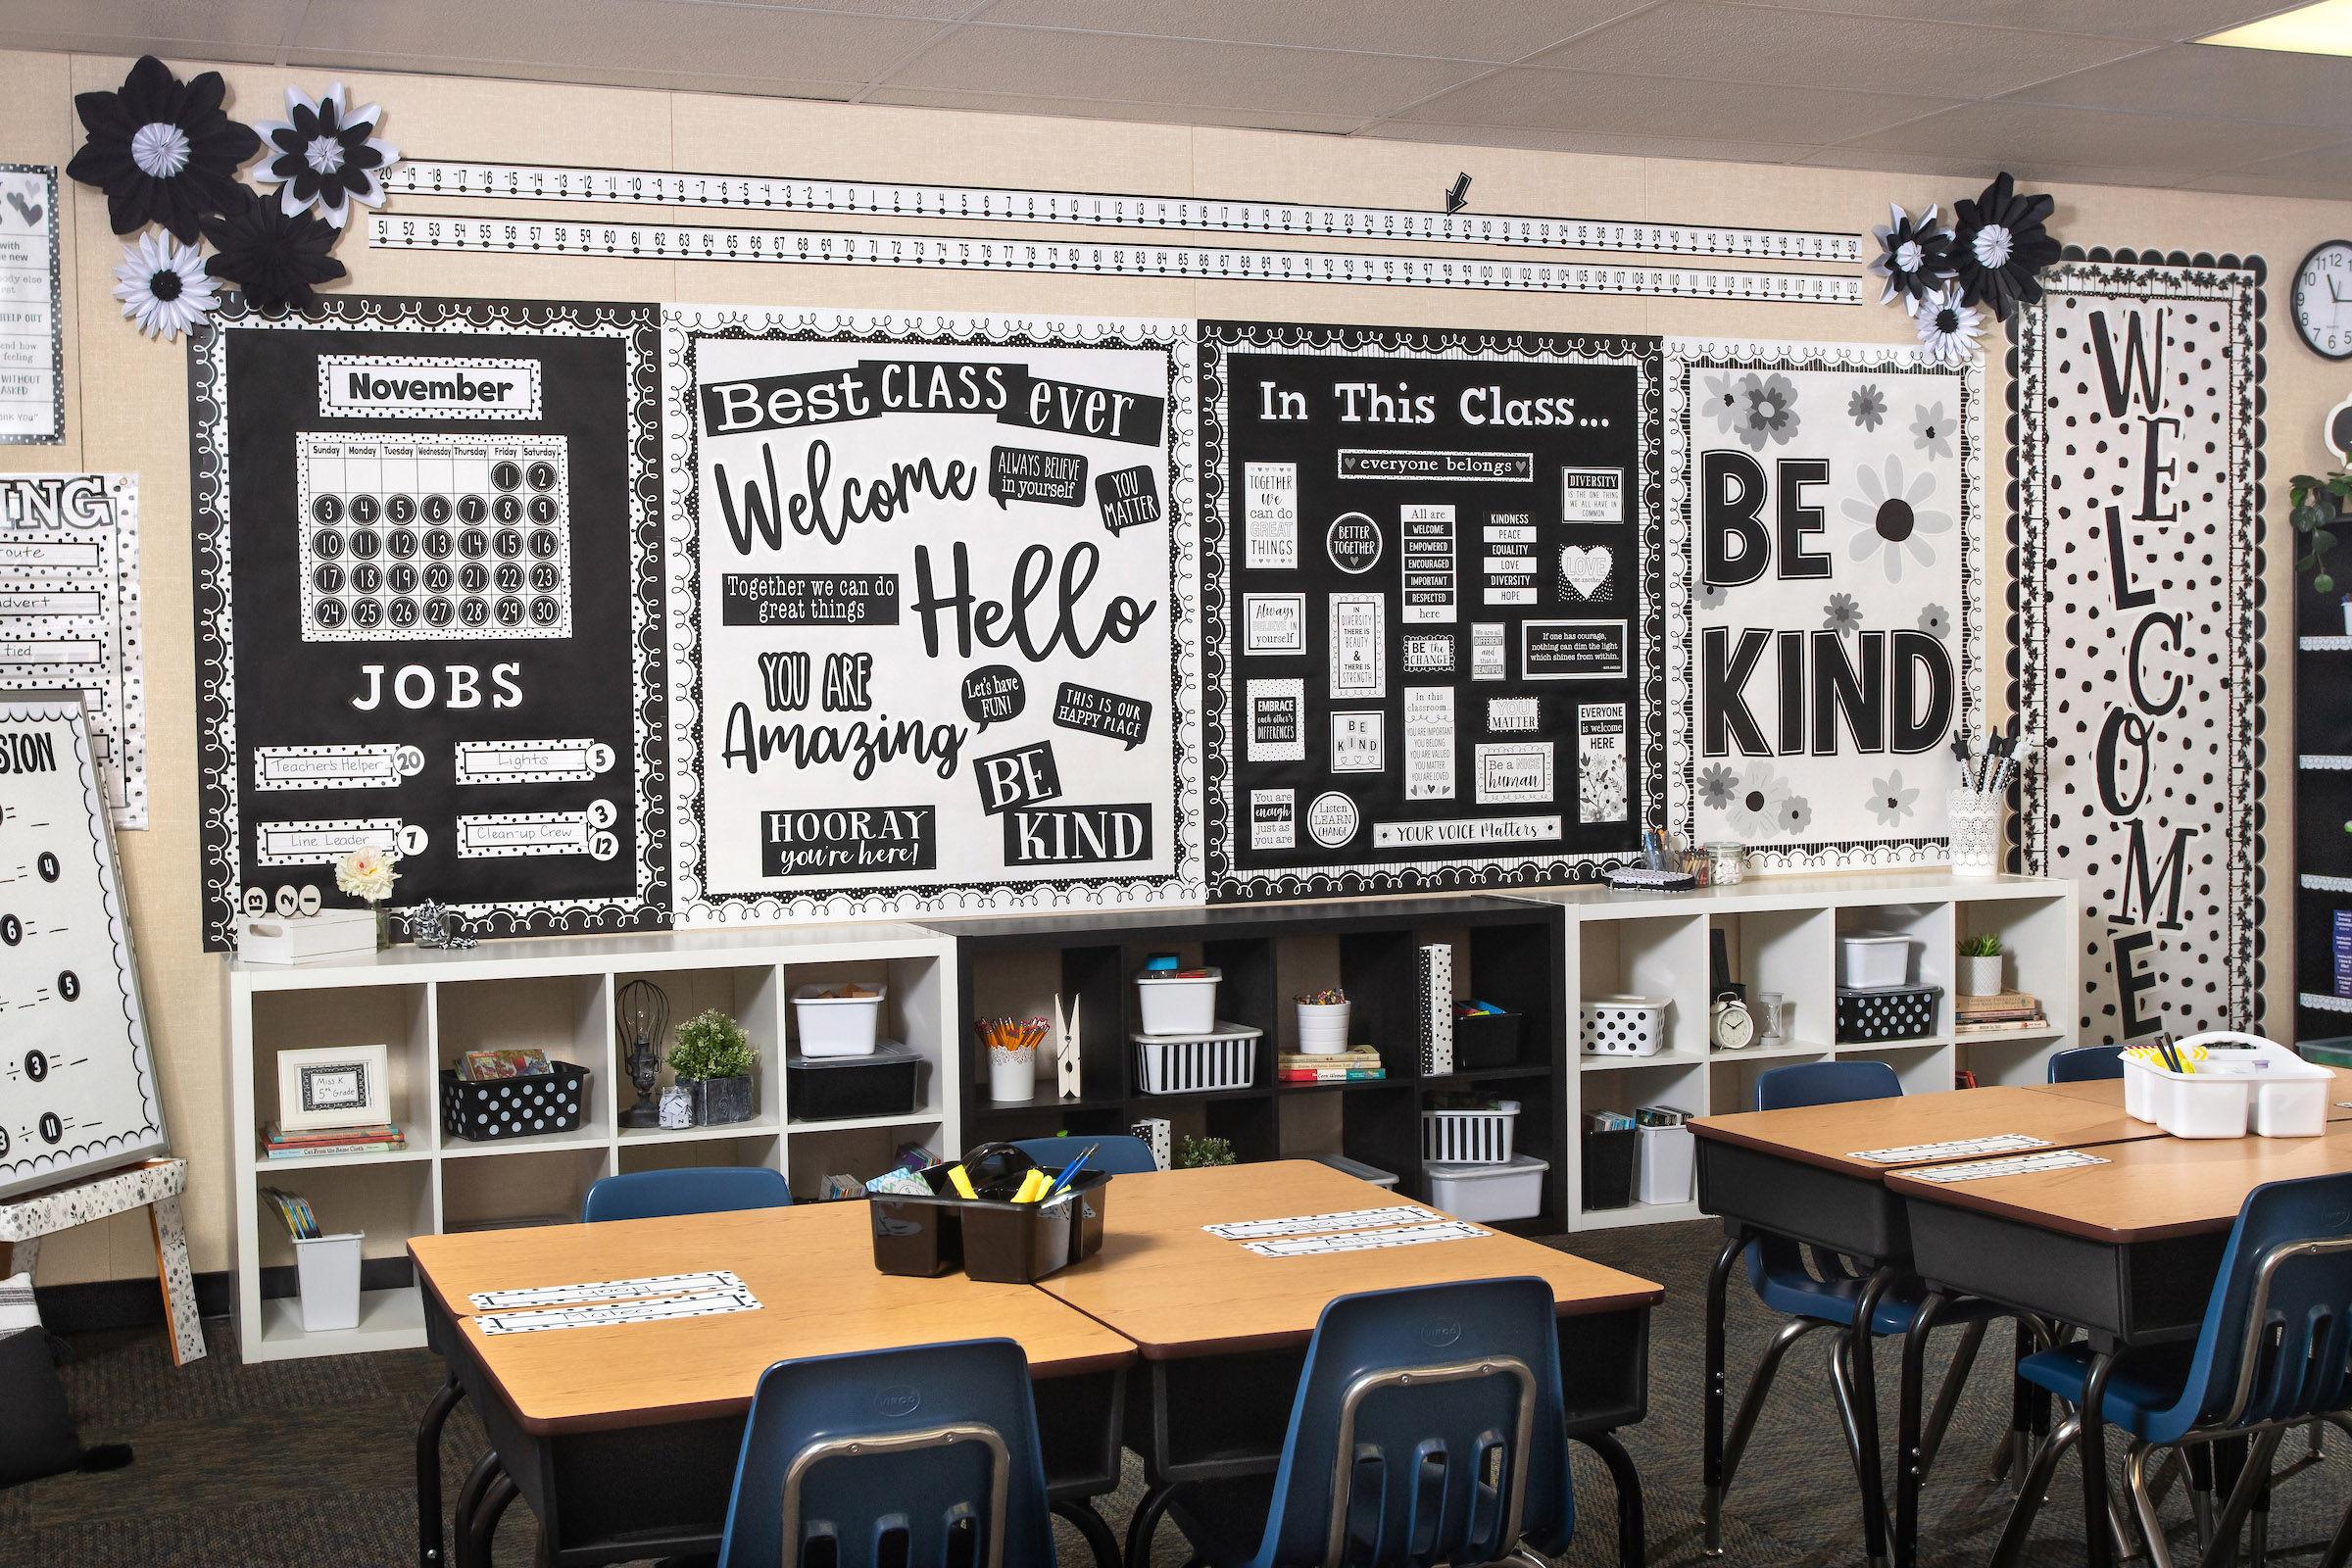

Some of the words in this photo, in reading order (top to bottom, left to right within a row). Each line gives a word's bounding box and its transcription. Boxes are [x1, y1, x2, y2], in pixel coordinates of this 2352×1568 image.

[402, 168, 416, 181] -19
[627, 176, 642, 191] -10
[849, 189, 855, 202] 0
[1282, 211, 1292, 223] 20
[1670, 230, 1680, 243] 40
[378, 221, 388, 234] 51
[1069, 249, 1080, 262] 80
[1669, 273, 1680, 285] 110
[2329, 254, 2342, 267] 12
[2304, 272, 2316, 286] 10
[25, 314, 42, 323] OUT
[20, 342, 37, 351] how
[2328, 335, 2335, 349] 6
[4, 354, 33, 364] feeling
[1, 375, 40, 385] WITHOUT
[349, 372, 514, 402] November
[1, 385, 28, 396] ASKED
[711, 370, 870, 433] Best
[881, 364, 1007, 410] CLASS
[1028, 380, 1135, 437] ever
[1259, 380, 1308, 421] In
[1335, 381, 1436, 425] This
[1459, 385, 1610, 429] Class...
[314, 446, 340, 456] Sunday
[348, 446, 376, 457] Monday
[384, 446, 414, 457] Tuesday
[418, 447, 451, 457] Wednesday
[454, 447, 487, 458] Thursday
[495, 447, 517, 458] Friday
[523, 447, 556, 458] Saturday
[998, 451, 1041, 477] ALWAYS
[1045, 456, 1081, 482] BELIEVE
[1360, 458, 1439, 473] everyone
[1446, 457, 1512, 475] belongs
[1001, 475, 1015, 493] in
[1017, 479, 1076, 499] yourself
[1111, 470, 1139, 499] YOU
[1250, 475, 1292, 490] TOGETHER
[1570, 475, 1617, 487] DIVERSITY
[713, 438, 977, 556] Welcome
[1103, 494, 1159, 527] MATTER
[1250, 510, 1273, 519] can
[1277, 508, 1293, 519] do
[1411, 509, 1427, 518] All
[1430, 511, 1446, 519] are
[1700, 449, 1833, 586] BE
[1491, 514, 1529, 524] KINDNESS
[1250, 521, 1293, 538] GREAT
[1339, 526, 1370, 540] BETTER
[1412, 524, 1445, 534] WELCOME
[1498, 529, 1521, 539] PEACE
[321, 536, 338, 554] 10
[1251, 540, 1293, 555] THINGS
[1334, 541, 1375, 555] TOGETHER
[1409, 542, 1447, 552] EMPOWERED
[1492, 545, 1528, 556] EQUALITY
[1408, 559, 1449, 569] ENCOURAGED
[1500, 560, 1520, 569] LOVE
[1567, 557, 1606, 576] LOVE
[431, 568, 447, 587] 20
[1410, 576, 1447, 586] IMPORTANT
[1491, 575, 1531, 586] DIVERSITY
[727, 575, 806, 601] Together
[810, 580, 833, 596] we
[839, 579, 869, 596] can
[875, 575, 895, 597] do
[911, 541, 1157, 662] Hello
[1411, 593, 1446, 603] RESPECTED
[1500, 591, 1520, 601] HOPE
[322, 604, 339, 622] 24
[537, 602, 553, 620] 30
[759, 599, 806, 623] great
[810, 599, 865, 623] things
[1419, 609, 1441, 618] here
[5, 644, 31, 657] tied
[762, 654, 808, 709] YOU
[825, 654, 870, 709] ARE
[2088, 308, 2198, 1041] WELCOME
[351, 662, 524, 711] JOBS
[965, 677, 992, 699] Let's
[992, 674, 1019, 694] have
[1700, 626, 1954, 758] KIND
[981, 695, 1012, 718] FUN!
[1066, 689, 1094, 710] THIS
[1099, 698, 1112, 713] IS
[1117, 702, 1141, 720] OUR
[1496, 702, 1531, 715] YOU
[1581, 707, 1623, 717] EVERYONE
[1057, 705, 1102, 728] HAPPY
[1103, 716, 1141, 738] PLACE
[1348, 720, 1366, 733] BE
[1492, 716, 1535, 728] MATTER
[1582, 723, 1589, 733] is
[1591, 721, 1622, 732] welcome
[722, 701, 968, 781] Amazing
[1338, 738, 1377, 752] KIND
[1591, 737, 1614, 749] HERE
[271, 757, 338, 772] Teacher's
[342, 760, 383, 772] Helper
[397, 751, 421, 771] 20
[498, 753, 549, 769] Lights
[595, 750, 606, 766] 5
[1489, 760, 1503, 769] Be
[1516, 758, 1541, 769] NICE
[984, 749, 1053, 808] BE
[1489, 771, 1540, 788] human
[1319, 803, 1348, 812] Listen
[768, 809, 930, 843] HOORAY
[1314, 814, 1352, 825] LEARN
[476, 825, 536, 842] Clean-up
[541, 825, 572, 839] Crew
[1014, 810, 1144, 860] KIND
[1318, 826, 1348, 837] CHANGE
[1397, 825, 1434, 842] YOUR
[1439, 824, 1475, 840] VOICE
[1481, 821, 1539, 838] Matters
[291, 834, 318, 847] Line
[325, 833, 370, 846] Leader
[407, 831, 416, 850] 7
[595, 839, 612, 856] 12
[780, 843, 856, 874] you're
[858, 843, 919, 865] here!
[44, 858, 54, 876] 4
[65, 976, 74, 995] 5
[333, 1088, 355, 1098] Grade
[46, 1118, 57, 1137] 11
[1324, 1236, 1385, 1246] Anita
[578, 1286, 652, 1296] Noah
[564, 1307, 653, 1320] Mateo
